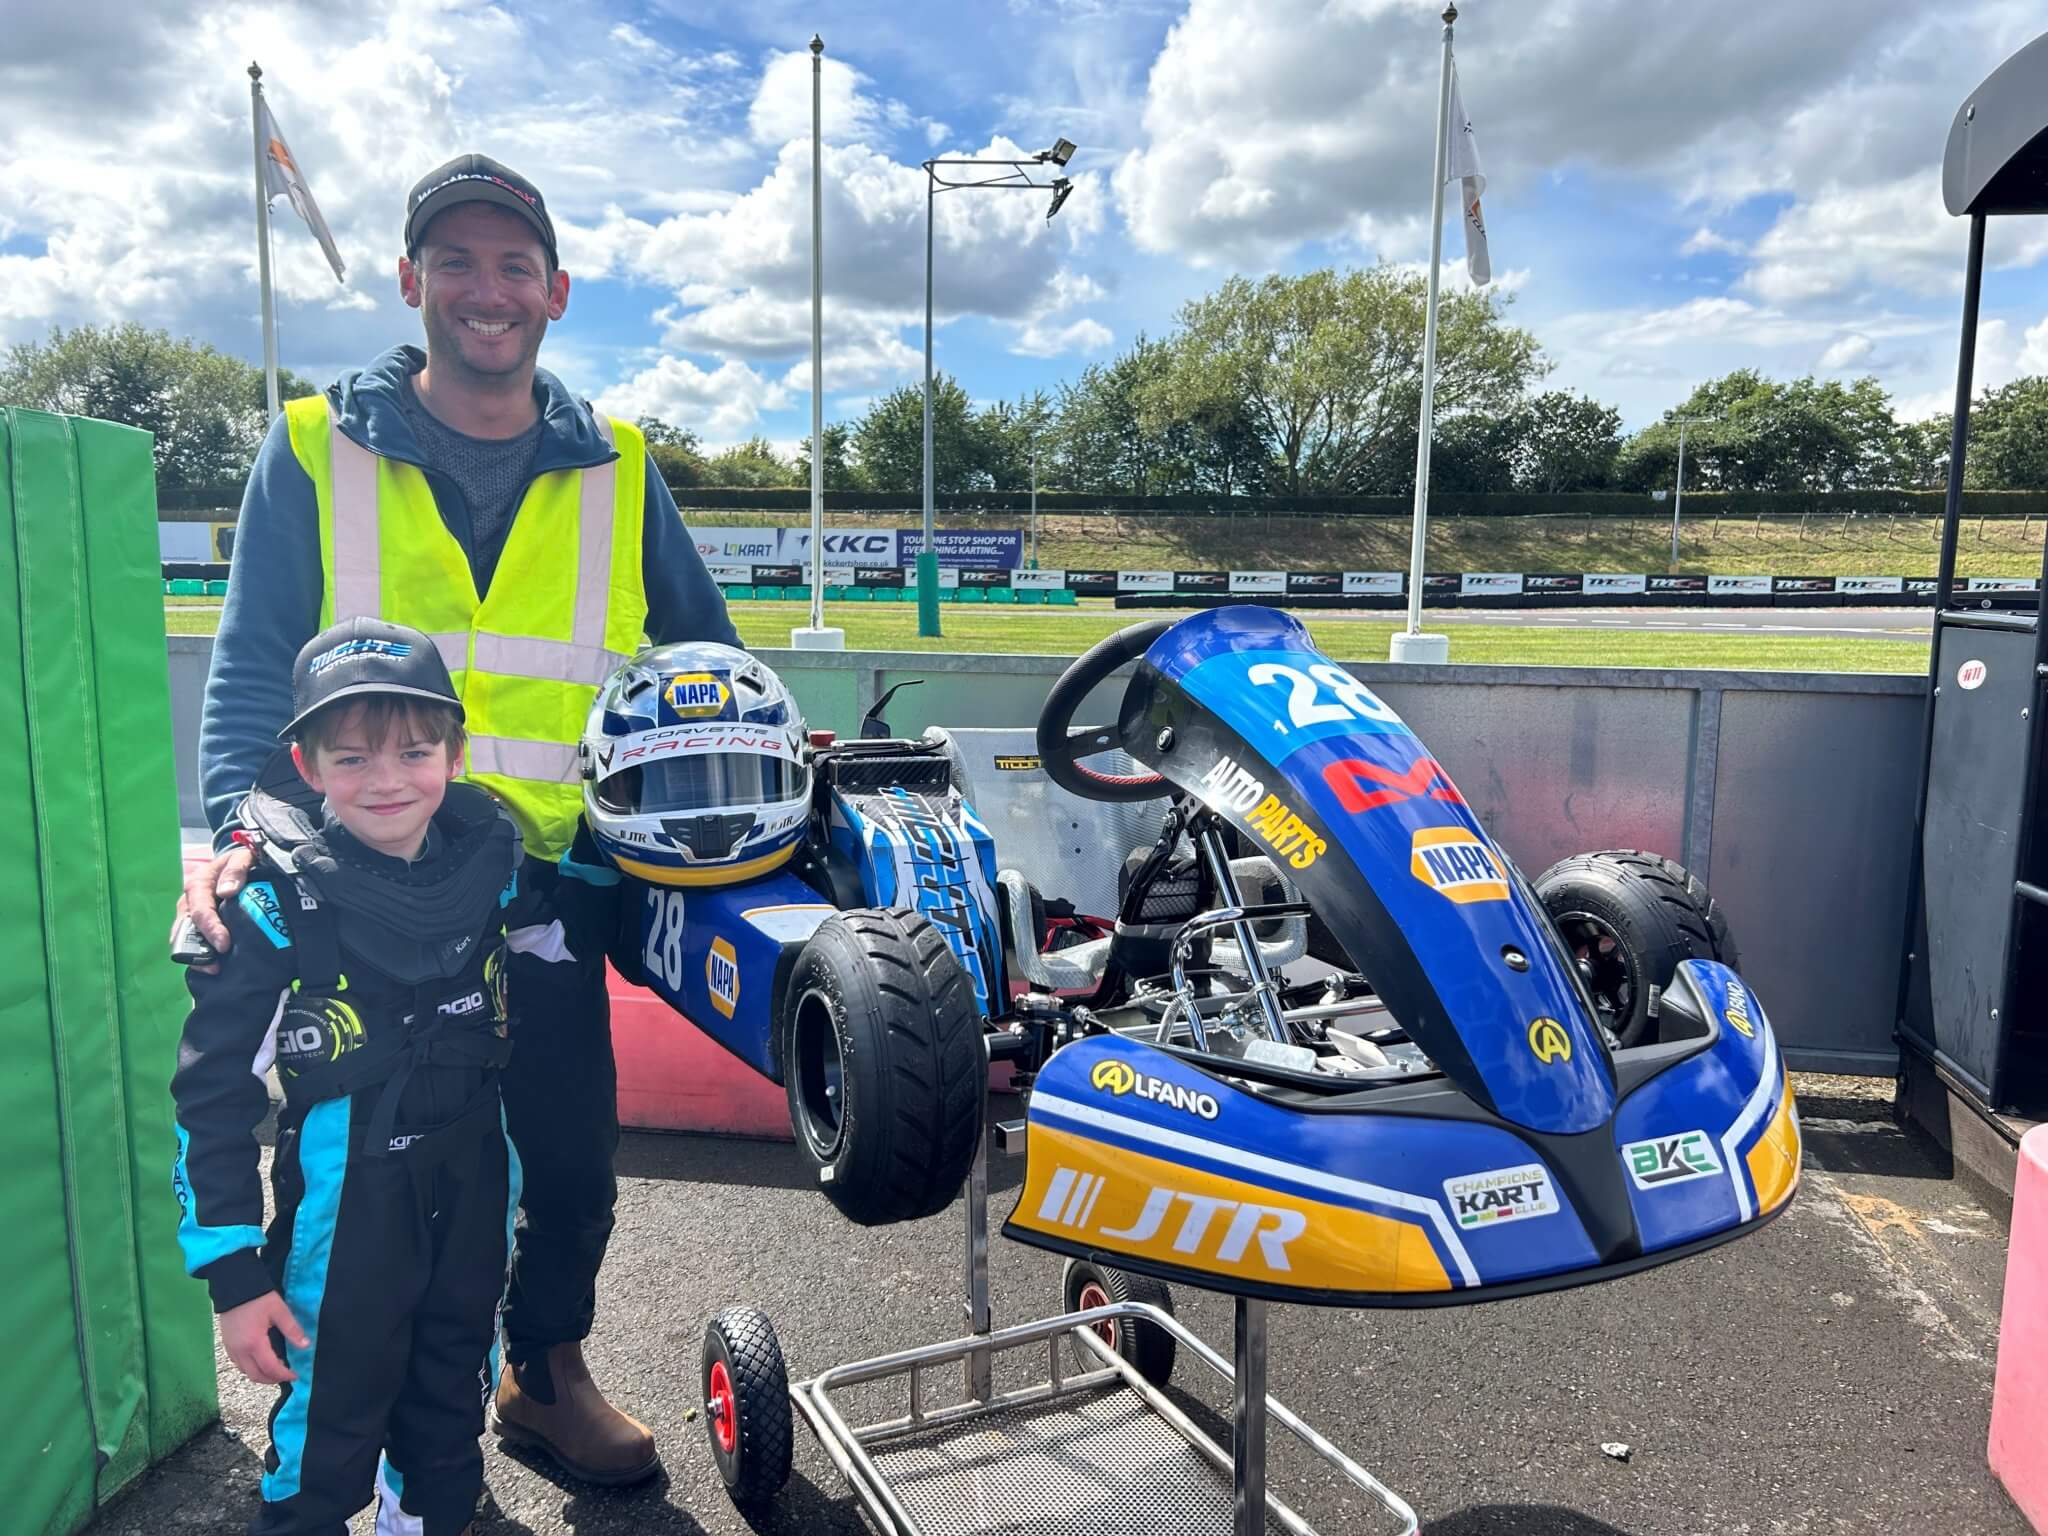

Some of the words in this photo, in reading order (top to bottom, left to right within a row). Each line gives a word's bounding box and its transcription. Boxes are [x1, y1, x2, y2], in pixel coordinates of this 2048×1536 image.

[948, 536, 971, 545] STOP
[972, 536, 997, 545] SHOP
[997, 536, 1016, 545] FOR
[316, 651, 407, 677] MOTORSPORT
[674, 683, 721, 706] NAPA
[1247, 663, 1402, 729] 28
[622, 737, 783, 762] RACING
[642, 726, 769, 742] CORVETTE
[1201, 756, 1265, 811] AUTO
[1245, 793, 1328, 870] PARTS
[628, 832, 647, 843] JTR
[1422, 845, 1503, 884] NAPA
[646, 887, 685, 992] 28
[711, 954, 734, 1001] NAPA
[1724, 981, 1755, 1038] ALFANO
[1090, 1060, 1220, 1119] ALFANO
[1630, 1134, 1719, 1183] BKC
[1452, 1169, 1543, 1194] CHAMPIONS
[1455, 1181, 1544, 1214] KART
[1515, 1202, 1547, 1214] CLUB
[1100, 1187, 1307, 1272] JTR
